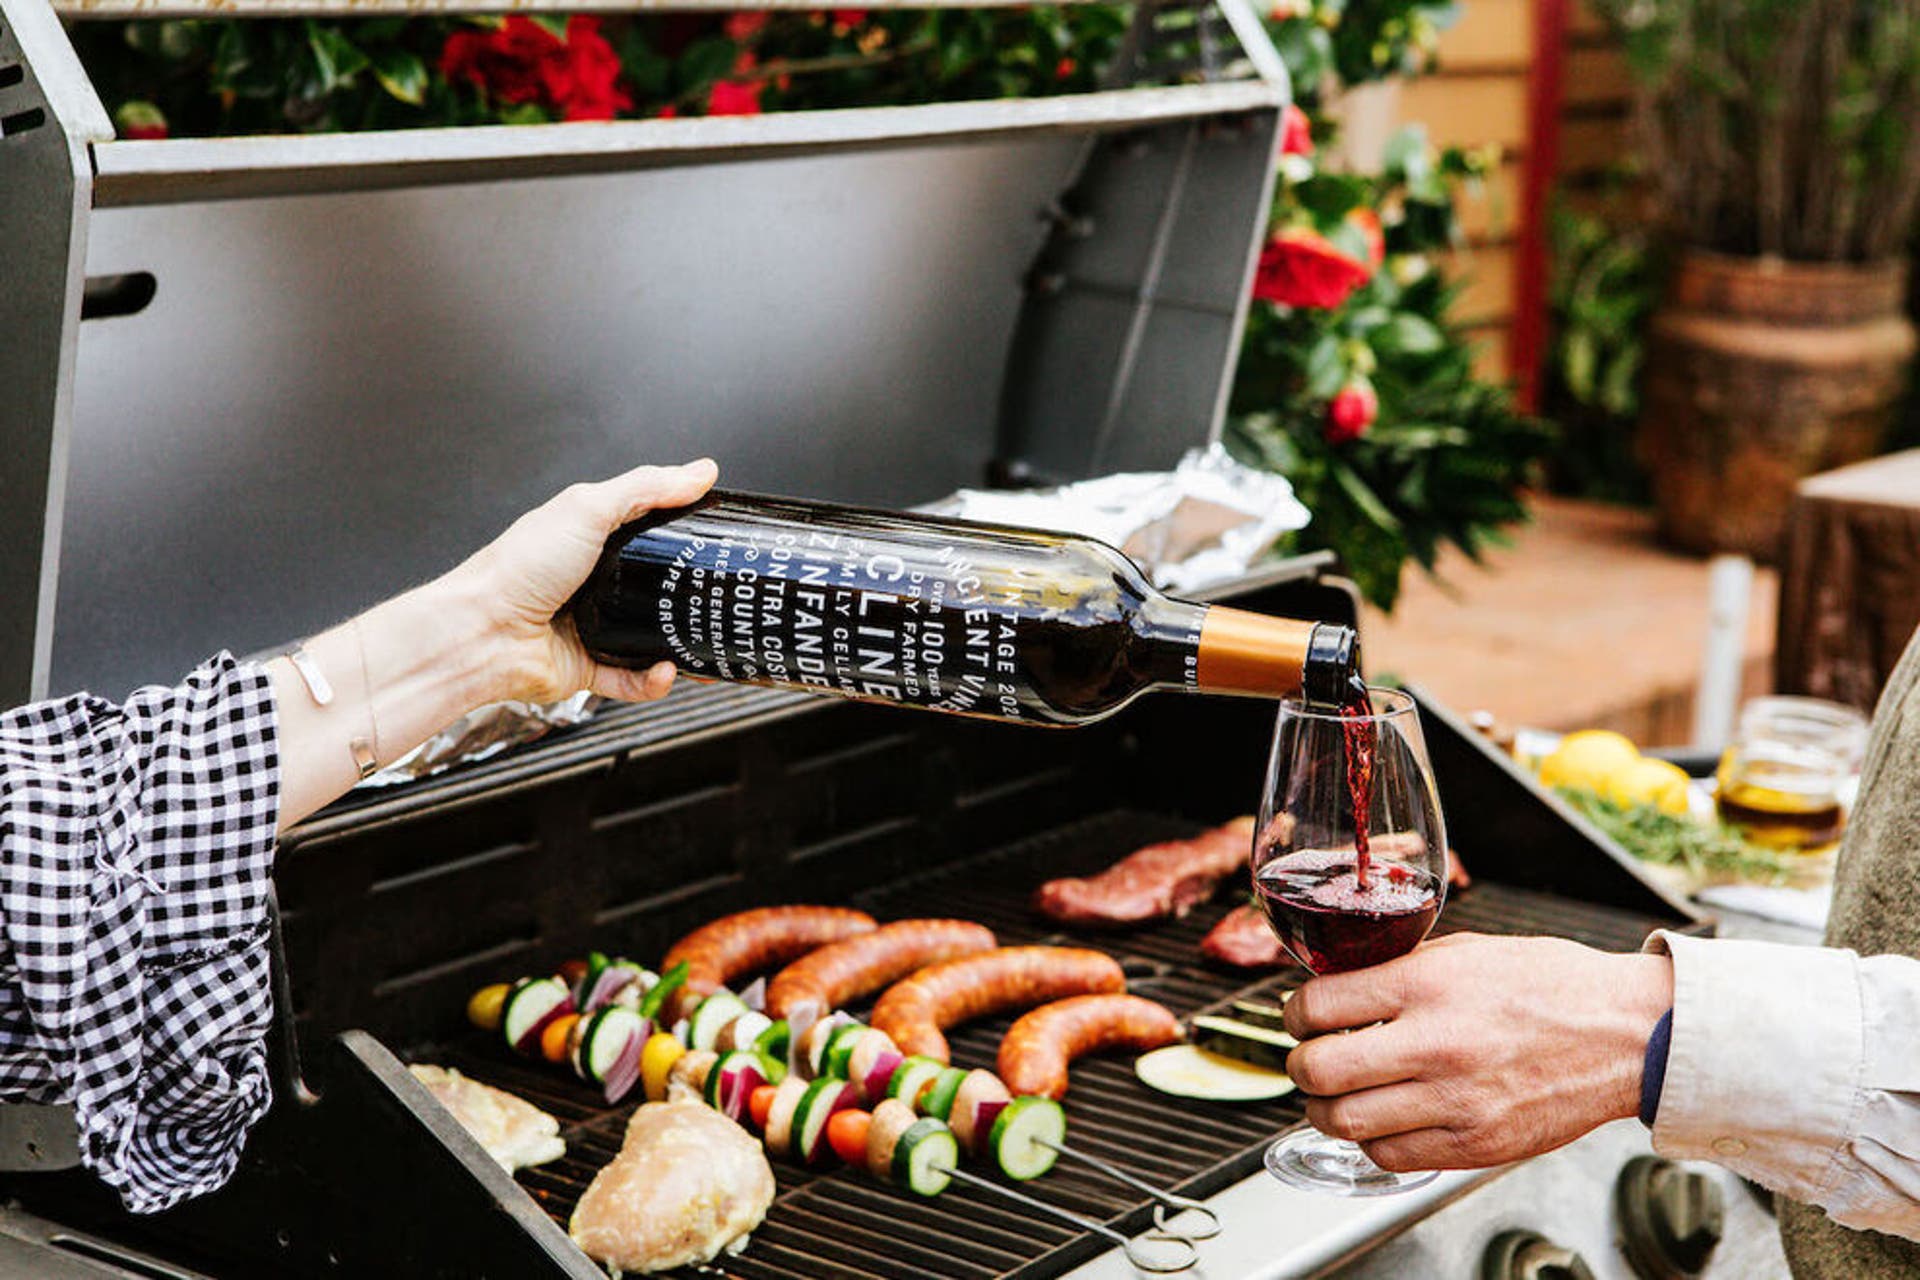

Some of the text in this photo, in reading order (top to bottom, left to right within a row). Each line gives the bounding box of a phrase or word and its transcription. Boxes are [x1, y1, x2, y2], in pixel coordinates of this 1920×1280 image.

[658, 537, 705, 668] GRAPE GROWING
[690, 567, 705, 645] OF CALIF.
[733, 568, 757, 663] COUNTY
[762, 533, 796, 627] CONTRA
[794, 532, 839, 693] ZINFANDE
[835, 541, 864, 617] FAMILY
[858, 554, 904, 700] CLINE
[902, 571, 924, 697] DRY FARMED
[936, 546, 990, 667] ANCIENT
[997, 568, 1025, 674] VINTAGE
[922, 582, 945, 697] OVER 100 YEARS
